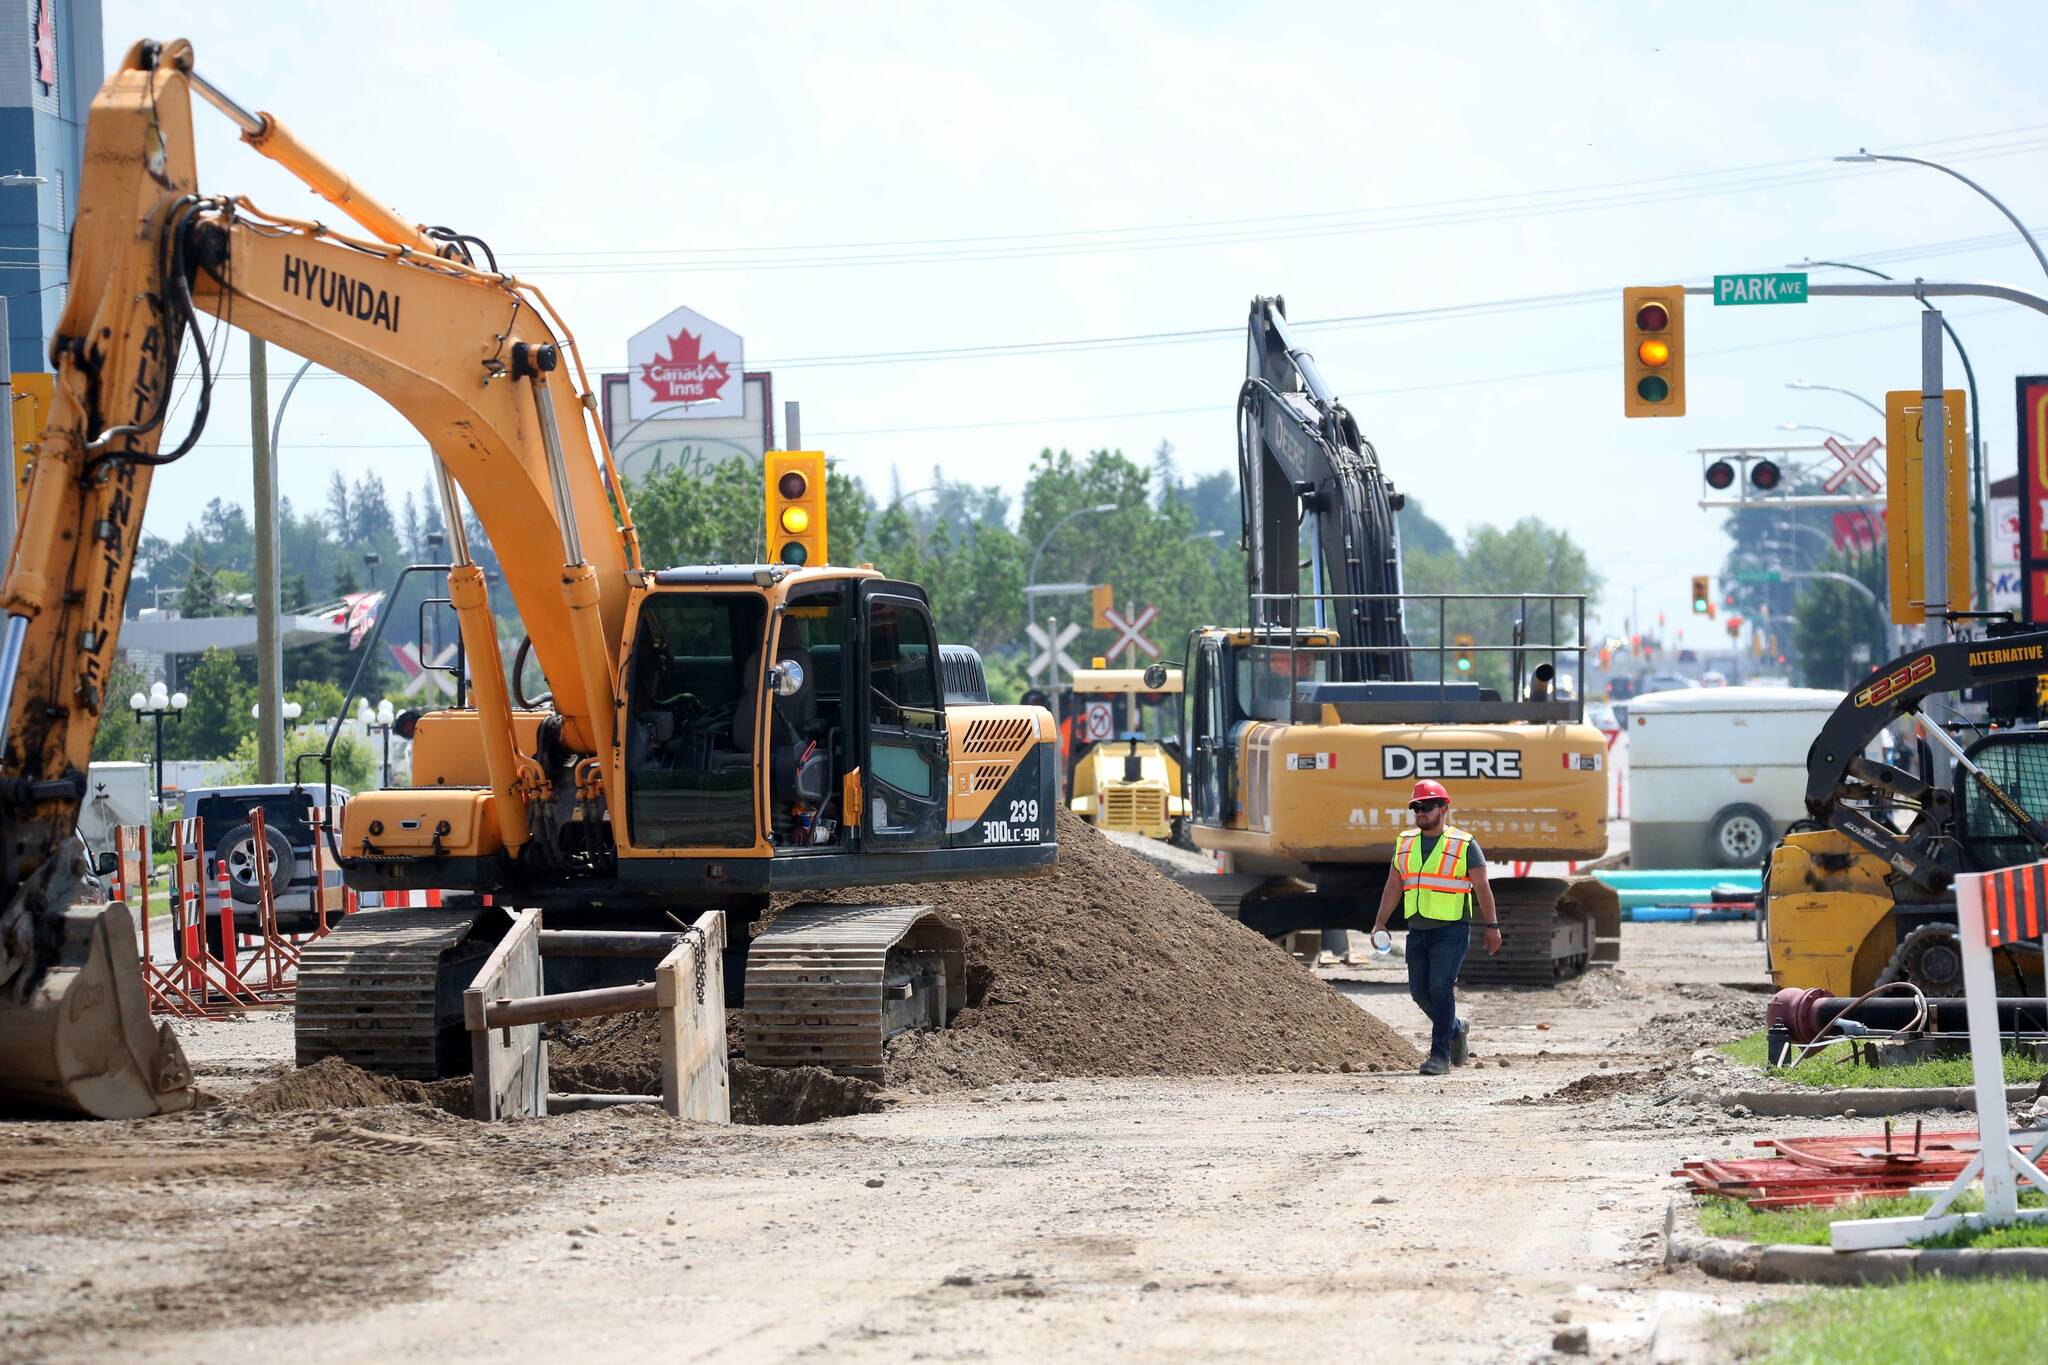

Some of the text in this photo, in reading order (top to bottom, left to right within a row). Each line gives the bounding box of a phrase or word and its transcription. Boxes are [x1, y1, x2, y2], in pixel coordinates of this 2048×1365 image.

[283, 253, 400, 333] HYUNDAI
[1720, 277, 1802, 301] PARK AVE
[669, 382, 704, 396] Inns
[1275, 411, 1306, 477] DEERE
[1969, 645, 2044, 668] ALTERNATIVE
[1384, 746, 1521, 779] DEERE
[1010, 799, 1038, 822] 239
[983, 820, 1040, 843] 300LC-9A
